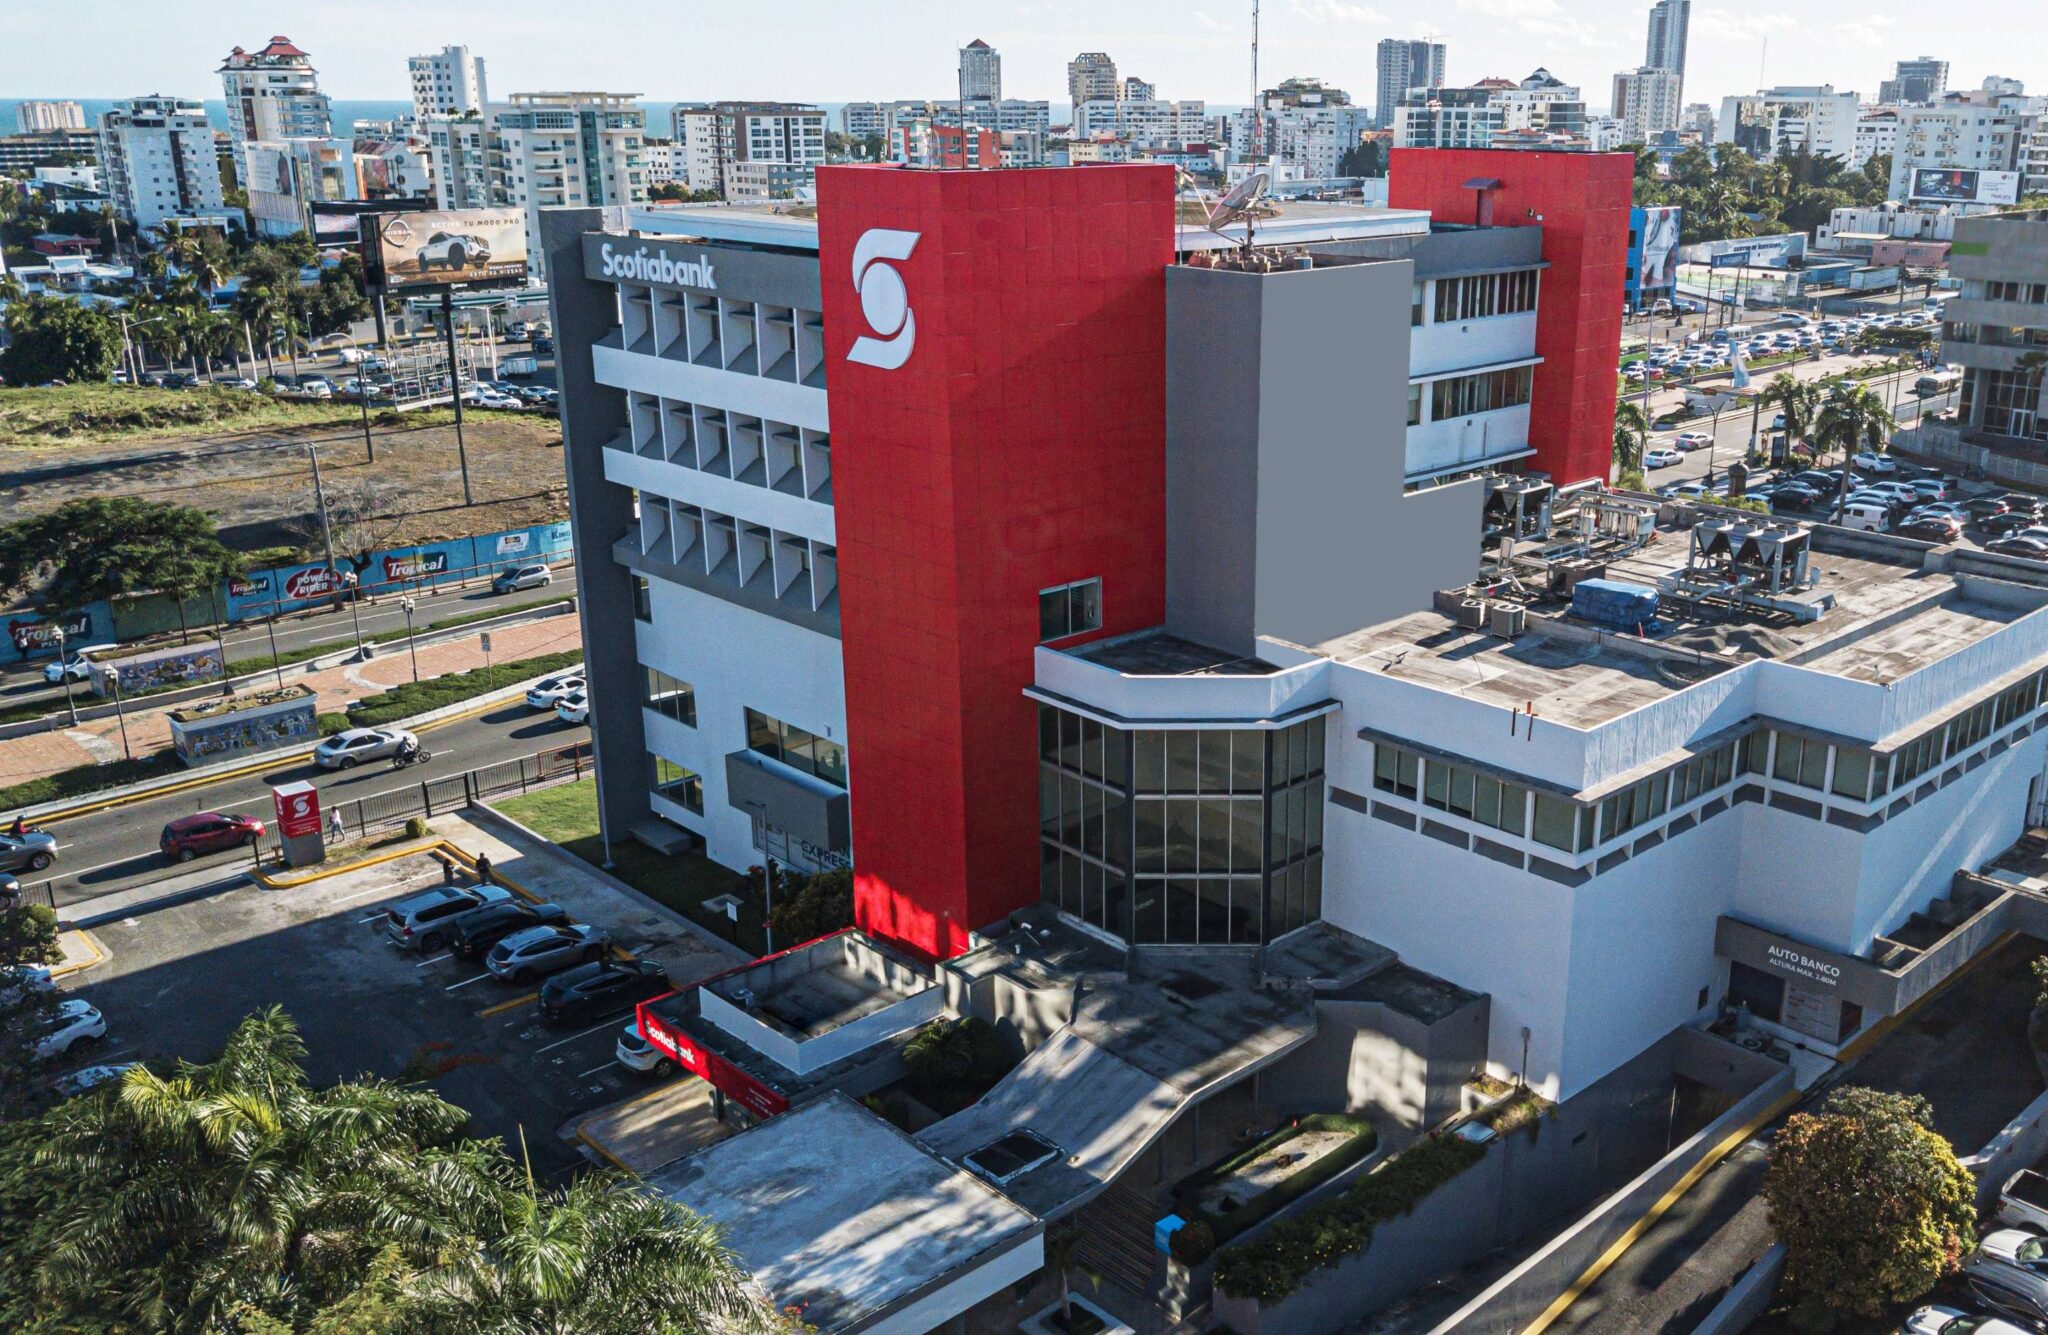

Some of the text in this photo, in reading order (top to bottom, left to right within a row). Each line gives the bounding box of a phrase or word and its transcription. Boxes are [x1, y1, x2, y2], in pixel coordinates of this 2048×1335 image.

[601, 242, 717, 289] Scotiabank
[388, 555, 444, 577] Tropical
[297, 573, 330, 585] POWER
[299, 581, 328, 595] RIDER
[1768, 945, 1840, 977] AUTO BANCO
[1769, 958, 1796, 972] ALTURA
